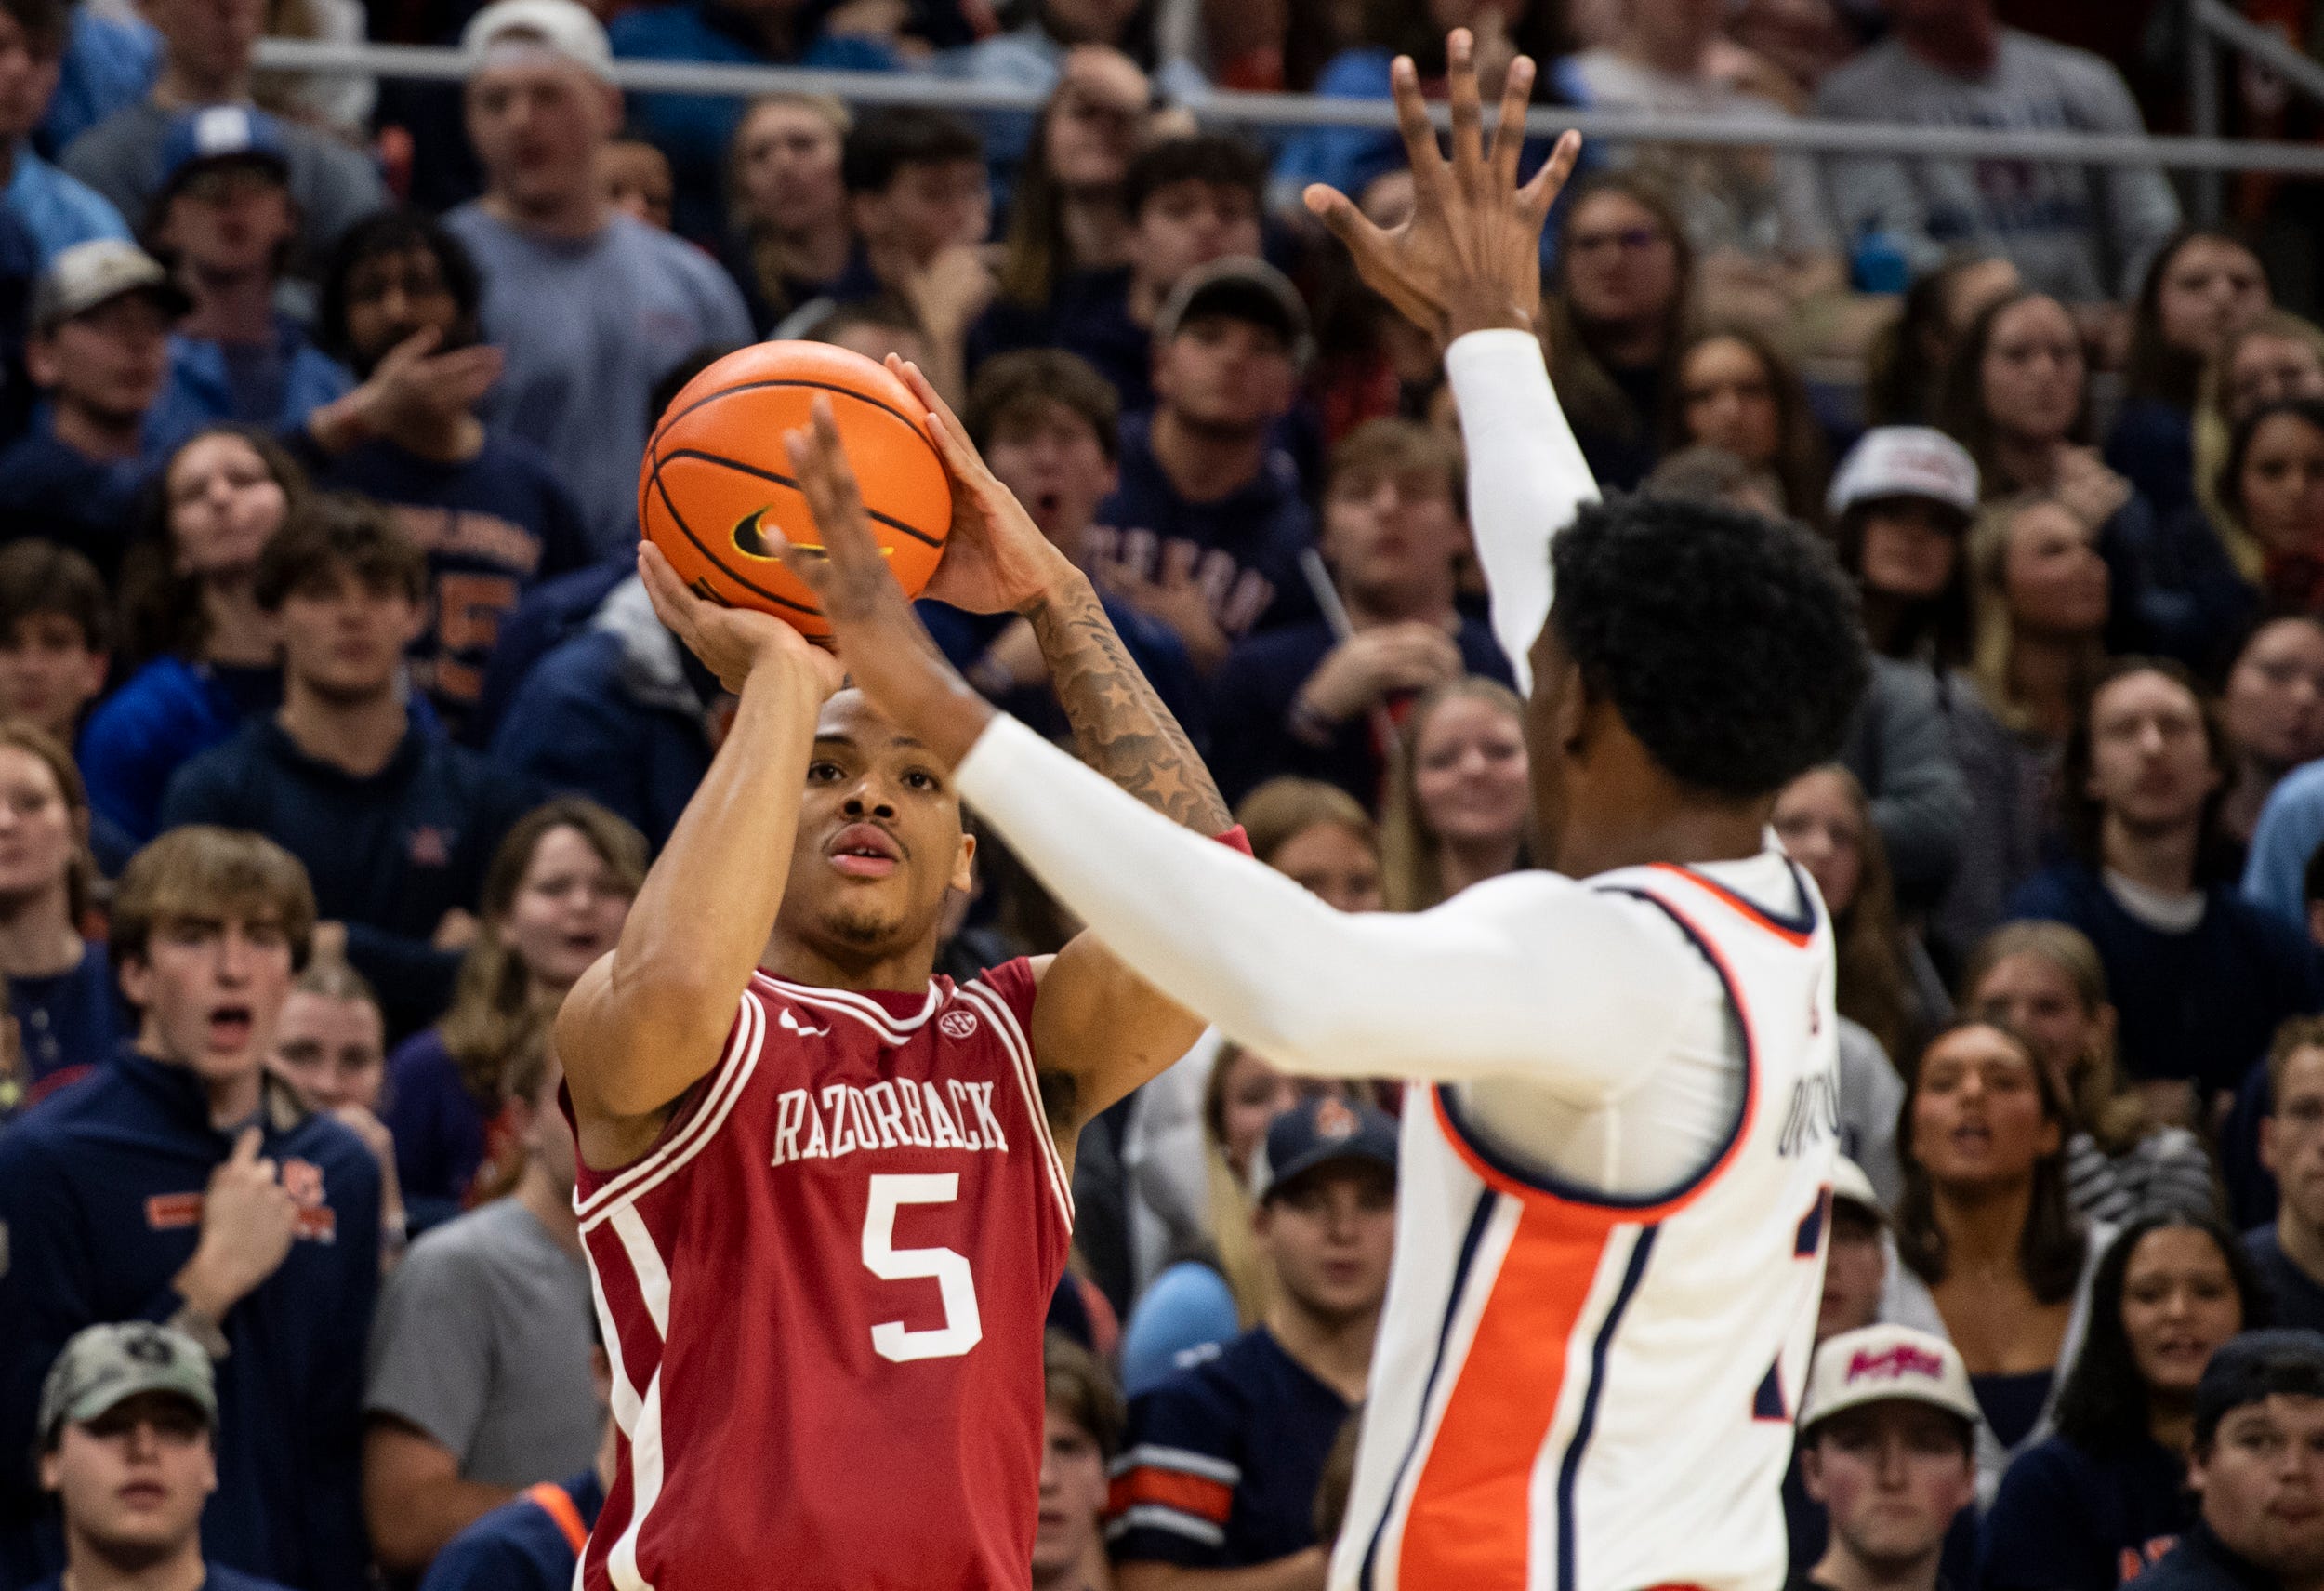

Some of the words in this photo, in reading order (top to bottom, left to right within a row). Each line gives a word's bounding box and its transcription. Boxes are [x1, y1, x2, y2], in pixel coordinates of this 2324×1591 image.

[940, 1011, 977, 1038] SEC
[772, 1076, 1009, 1167] RAZORBACK
[862, 1173, 983, 1363] 5
